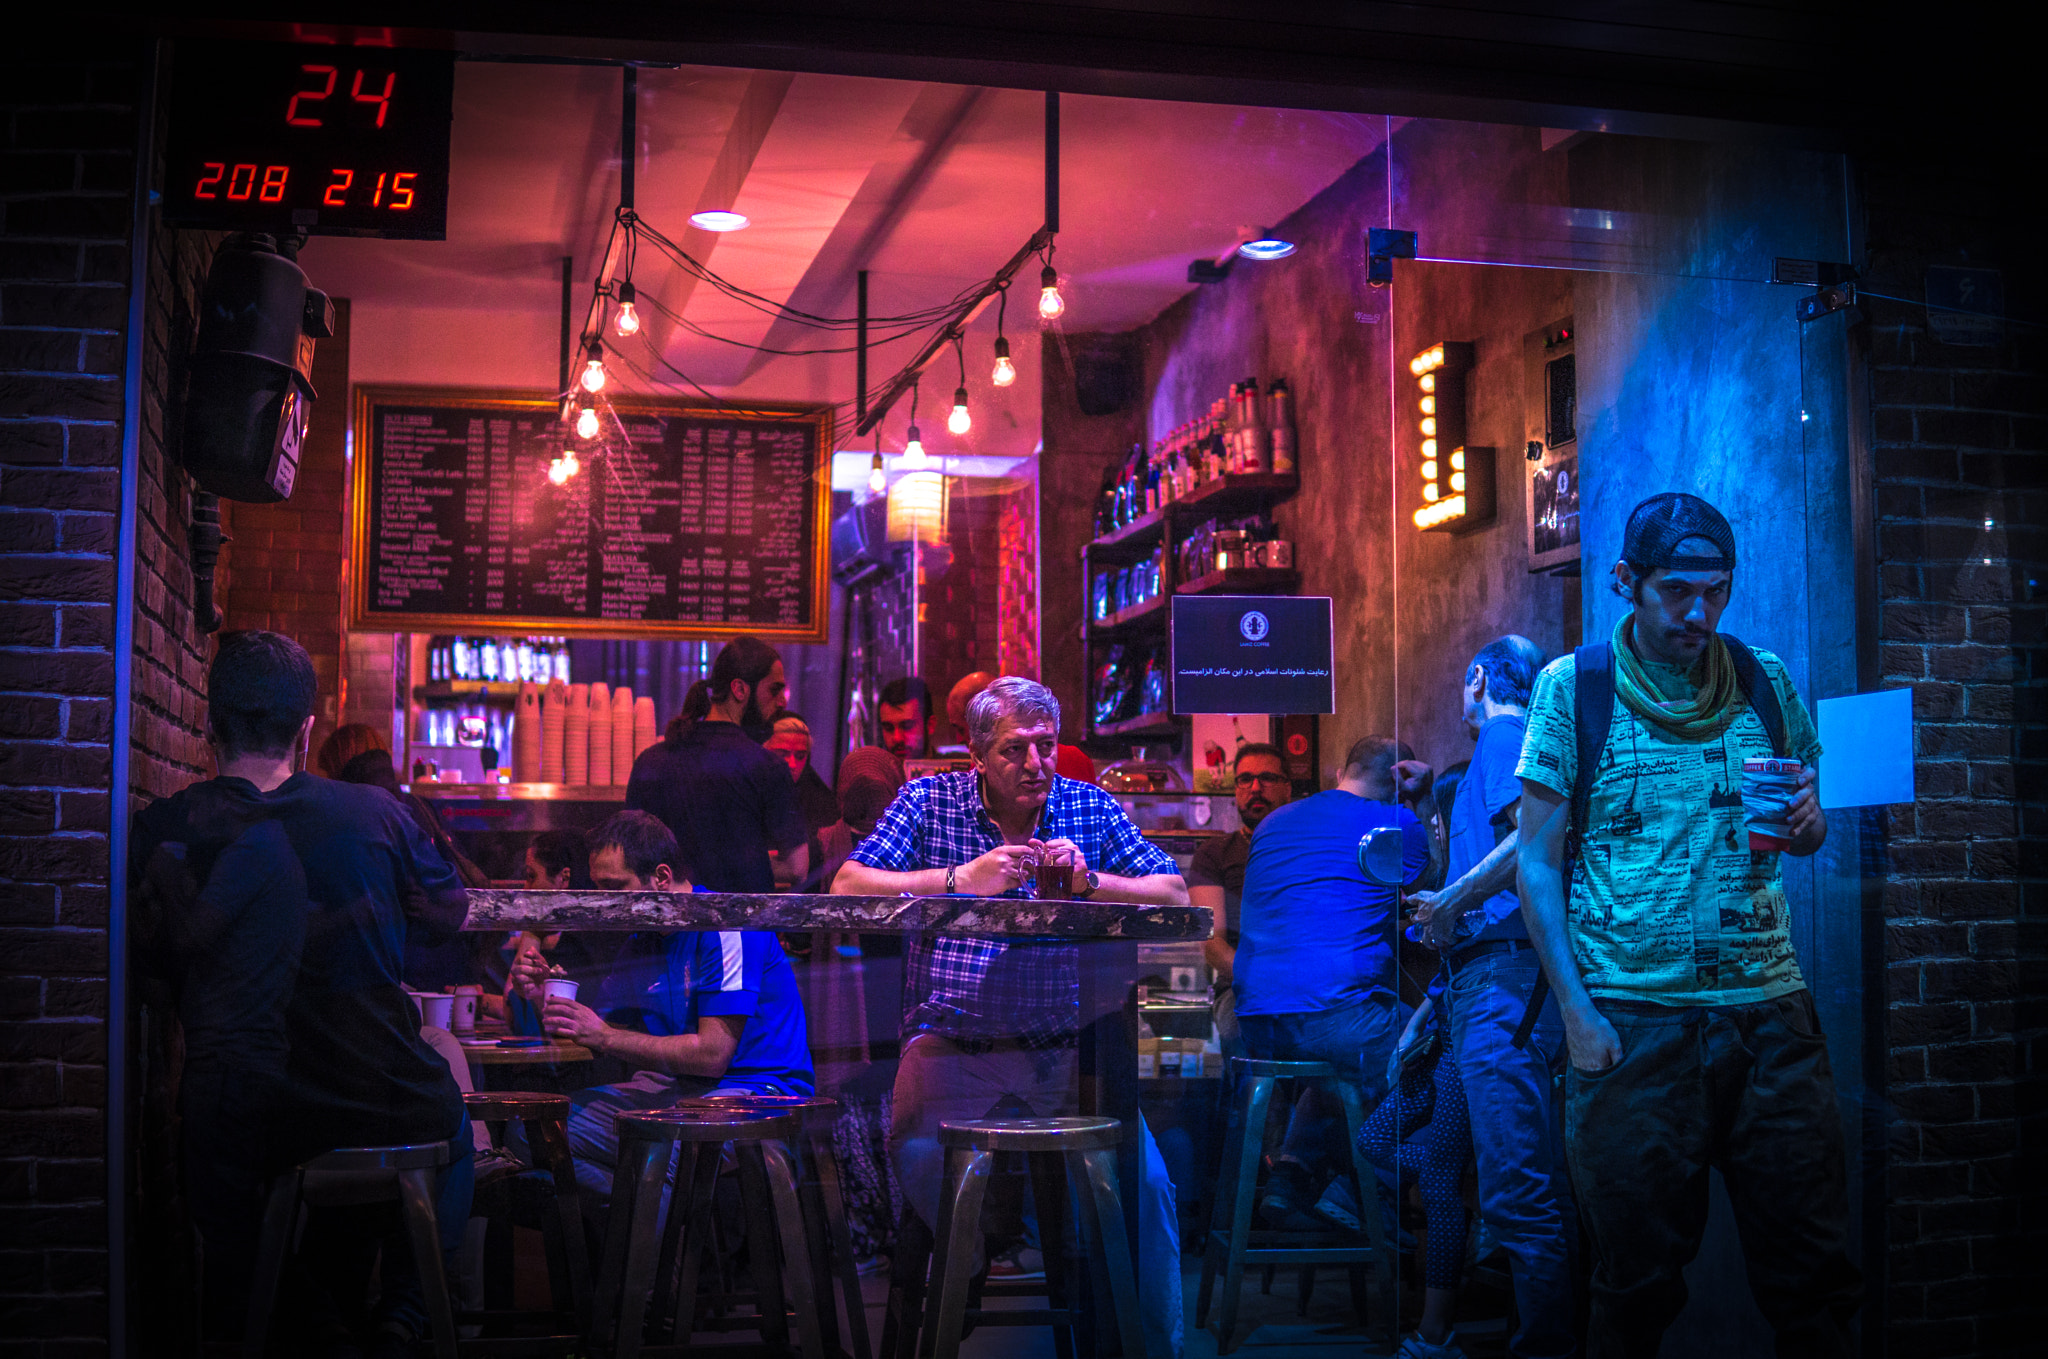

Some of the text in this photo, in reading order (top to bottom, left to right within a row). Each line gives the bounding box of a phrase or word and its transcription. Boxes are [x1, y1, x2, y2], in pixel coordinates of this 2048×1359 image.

[285, 64, 397, 128] 24
[195, 162, 418, 210] 208 215
[1213, 667, 1231, 677] مکان
[1231, 667, 1243, 678] این
[1244, 668, 1254, 677] در
[1254, 667, 1279, 677] اسلامی
[1306, 668, 1329, 676] رعایت
